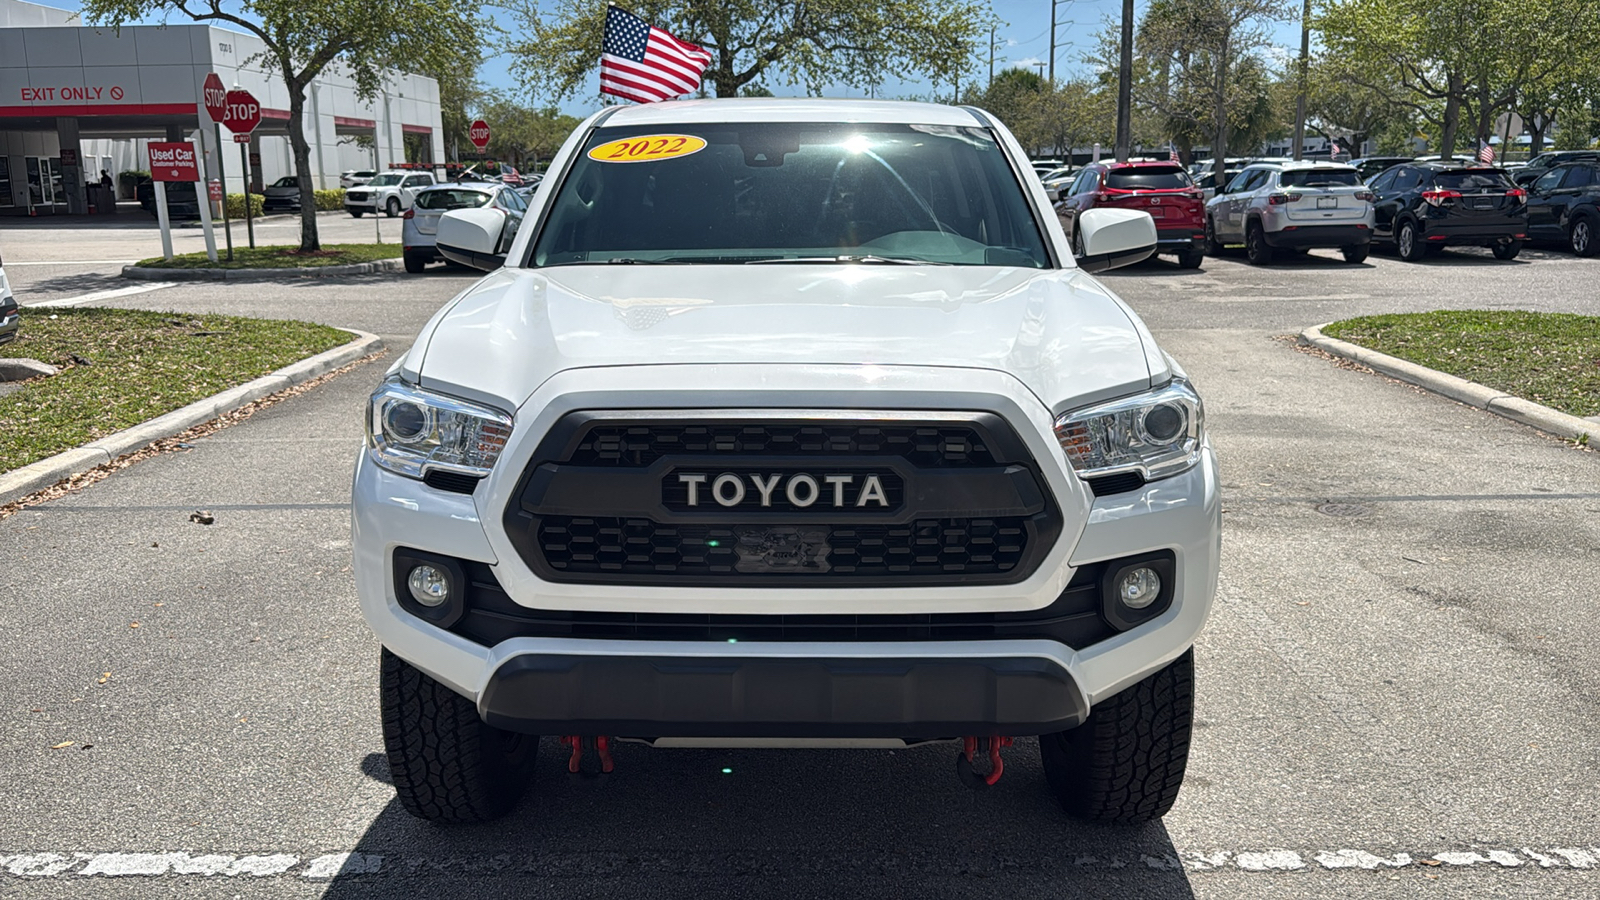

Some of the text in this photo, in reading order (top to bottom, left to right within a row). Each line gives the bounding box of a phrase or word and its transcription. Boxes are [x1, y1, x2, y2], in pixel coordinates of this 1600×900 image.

[21, 86, 103, 100] EXIT ONLY
[206, 88, 225, 108] STOP
[224, 104, 258, 120] STOP
[472, 128, 489, 140] STOP
[150, 148, 193, 160] Used Car
[608, 138, 687, 158] 2022
[677, 471, 890, 509] TOYOTA
